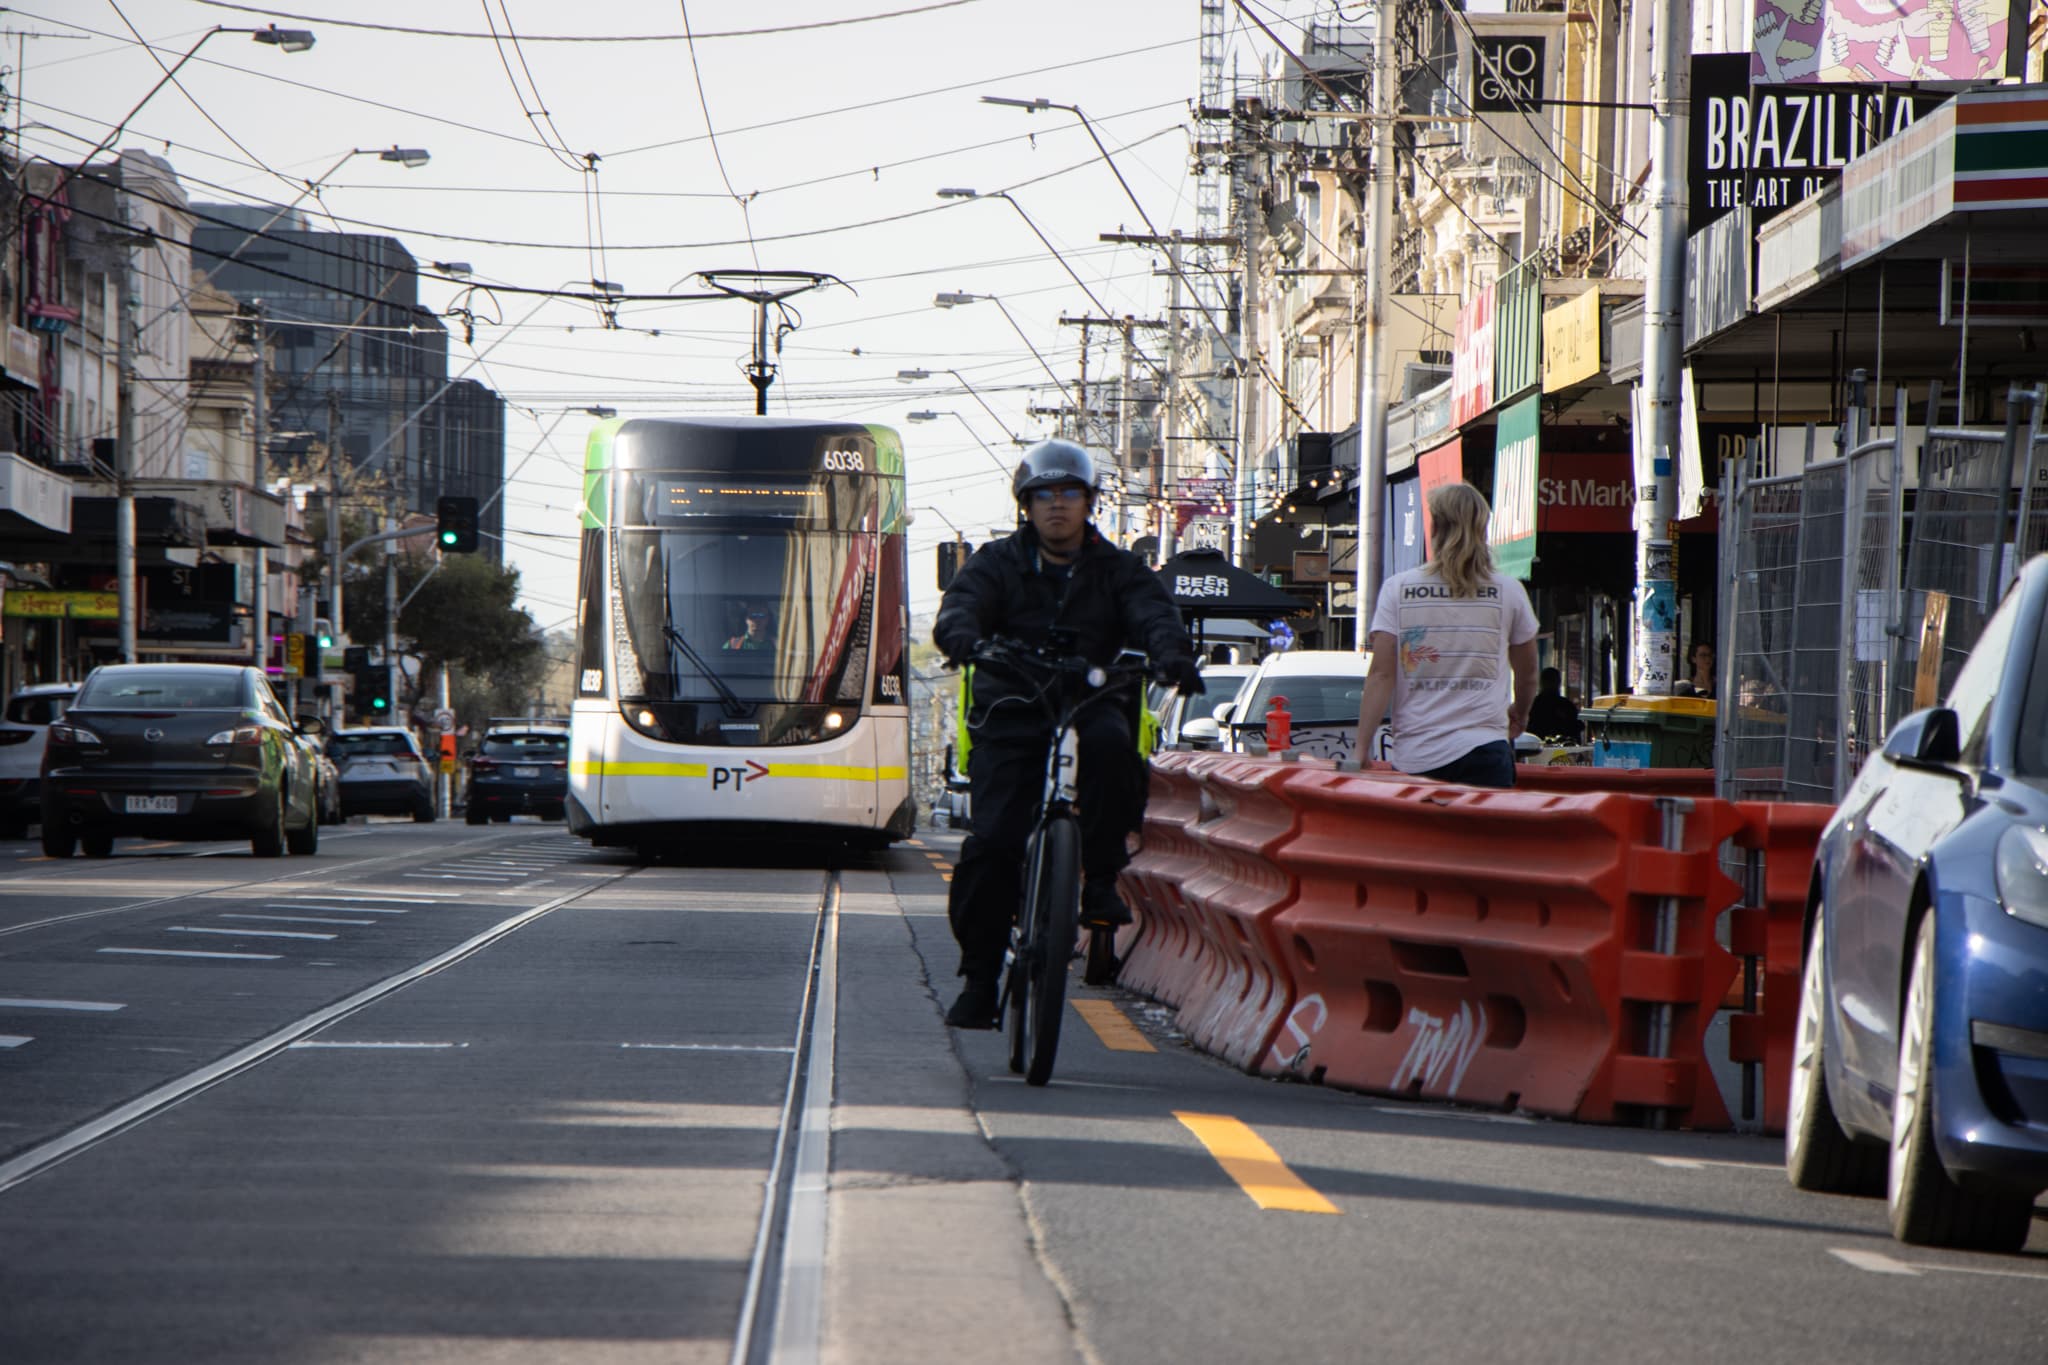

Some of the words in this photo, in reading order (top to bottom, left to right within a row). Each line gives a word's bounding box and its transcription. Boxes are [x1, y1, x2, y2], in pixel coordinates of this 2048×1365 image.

[1480, 44, 1536, 76] HO
[1480, 78, 1535, 100] GAN
[1707, 178, 1742, 207] THE
[1754, 177, 1791, 207] ART
[824, 450, 865, 472] 6038
[1538, 477, 1567, 507] St
[1174, 586, 1230, 597] MASH
[1175, 574, 1230, 588] BEER
[881, 674, 901, 697] 6038
